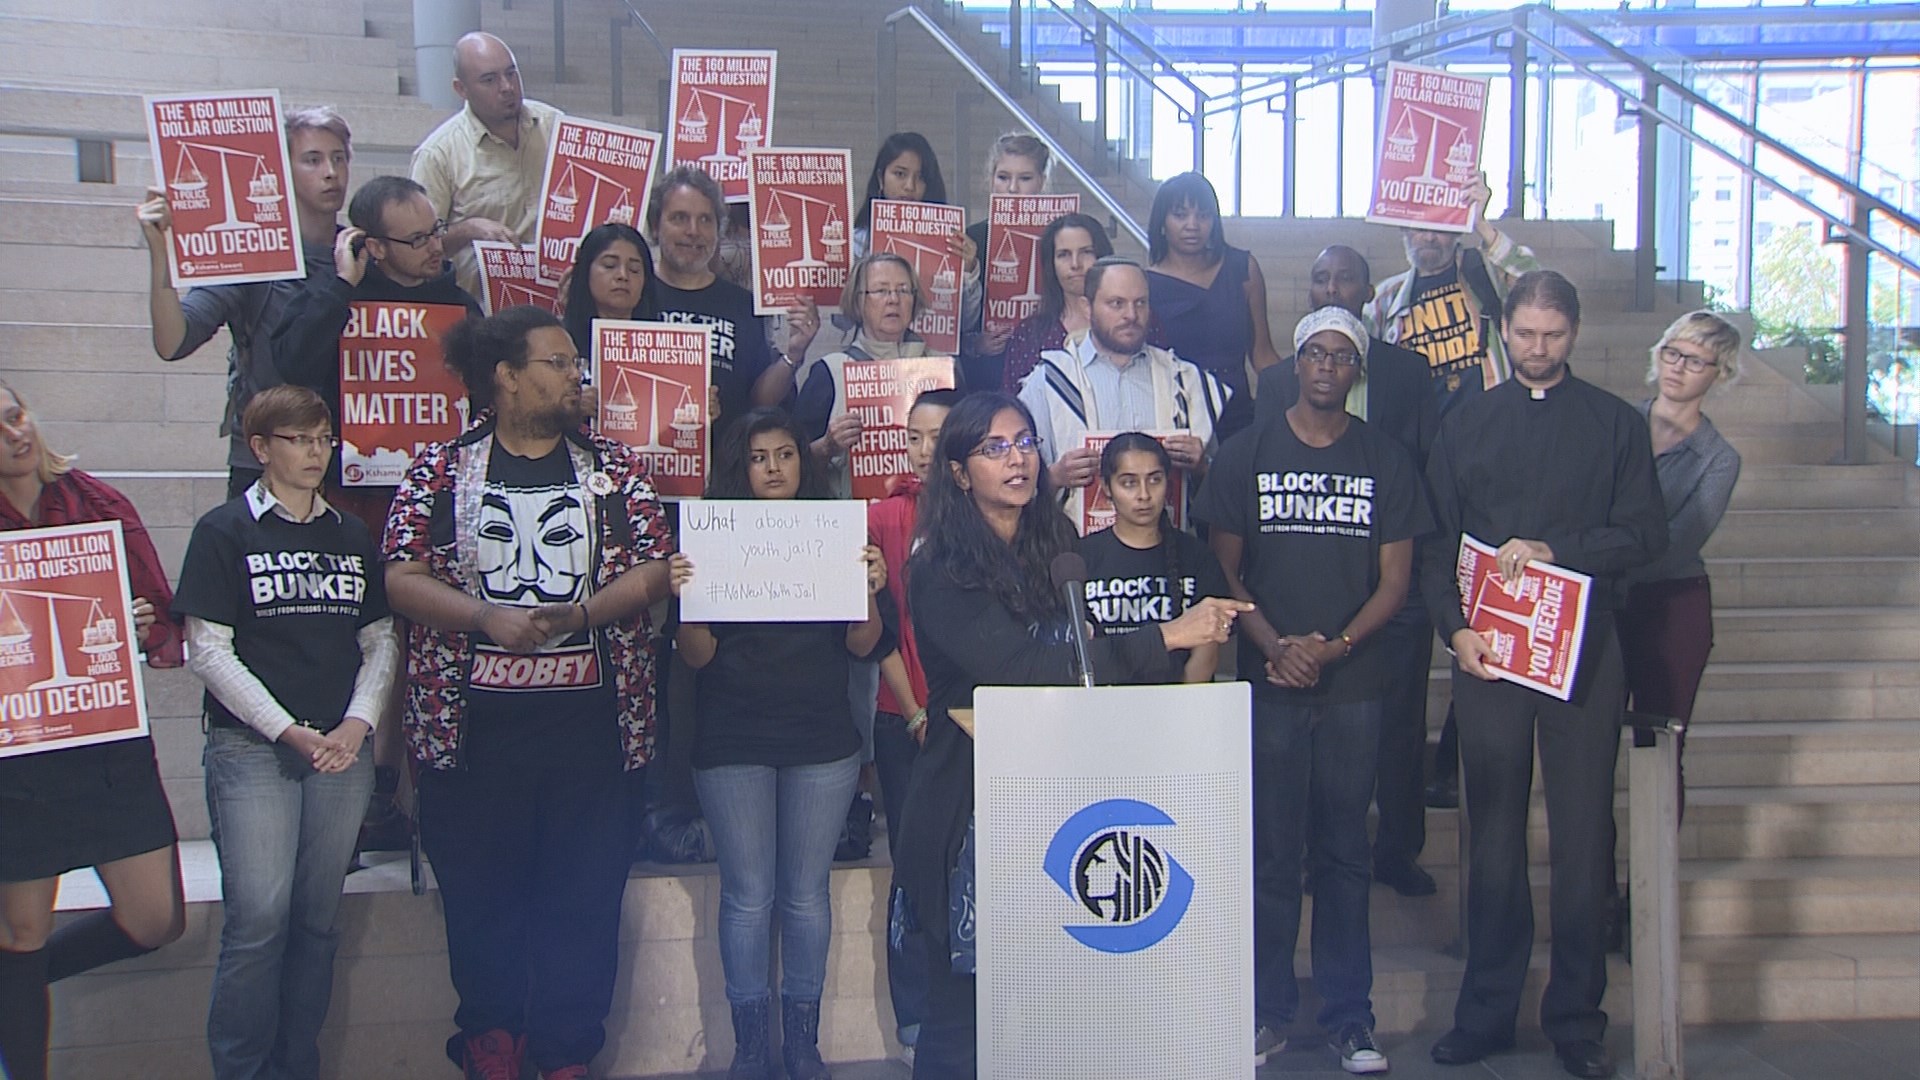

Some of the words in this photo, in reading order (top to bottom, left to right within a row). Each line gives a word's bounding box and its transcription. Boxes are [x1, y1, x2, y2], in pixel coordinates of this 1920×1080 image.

[682, 58, 700, 72] THE
[706, 58, 724, 72] 160
[726, 58, 768, 72] MILLION
[682, 72, 718, 85] DOLLAR
[720, 72, 766, 86] QUESTION
[1396, 72, 1416, 87] THE
[1420, 74, 1440, 90] 160
[1441, 78, 1482, 97] MILLION
[1394, 86, 1432, 103] DOLLAR
[1434, 92, 1481, 111] QUESTION
[157, 104, 185, 121] THE
[190, 103, 214, 119] 160
[218, 100, 270, 117] MILLION
[161, 120, 210, 137] DOLLAR
[214, 118, 274, 135] QUESTION
[562, 126, 581, 142] THE
[585, 130, 604, 146] 160
[606, 134, 650, 156] MILLION
[558, 141, 596, 162] DOLLAR
[597, 148, 648, 170] QUESTION
[756, 156, 777, 170] THE
[780, 156, 800, 170] 160
[802, 156, 842, 170] MILLION
[710, 161, 748, 180] DECID
[758, 171, 796, 184] DOLLAR
[798, 171, 844, 185] QUESTION
[1380, 180, 1410, 202] YOU
[172, 200, 210, 210] PRECINCT
[876, 204, 896, 218] THE
[900, 206, 919, 220] 160
[921, 208, 960, 223] MILLION
[994, 199, 1014, 212] THE
[1018, 199, 1036, 212] 160
[1038, 199, 1075, 212] MILLION
[876, 218, 913, 234] DOLLAR
[994, 213, 1030, 226] DOLLAR
[178, 231, 218, 256] YOU
[223, 228, 290, 254] DECIDE
[543, 237, 569, 262] YOU
[764, 268, 794, 288] YOU
[798, 268, 846, 288] DECIDE
[989, 300, 1016, 318] YOU
[344, 307, 428, 338] BLACK
[699, 315, 734, 338] THE
[910, 315, 954, 335] ECIDE
[604, 331, 626, 347] THE
[631, 332, 652, 348] 160
[656, 334, 702, 350] MILLION
[344, 350, 416, 382] LIVES
[604, 349, 646, 362] DOLLAR
[650, 350, 702, 365] QUESTION
[846, 366, 877, 382] MAKE
[344, 393, 448, 424] MATTER
[853, 453, 912, 477] HOUSIN
[1257, 472, 1328, 493] BLOCK
[1332, 474, 1374, 497] THE
[687, 504, 736, 532] What
[756, 508, 802, 530] about
[816, 514, 840, 530] the
[1259, 494, 1371, 524] BUNKER
[11, 542, 41, 562] 160
[44, 534, 110, 558] MILLION
[740, 541, 780, 567] youth
[784, 539, 824, 562] jail?
[0, 561, 36, 583] LLAR
[38, 554, 113, 578] QUESTION
[246, 551, 324, 574] BLOCK
[324, 552, 364, 574] THE
[250, 573, 366, 604] BUNKER
[1086, 576, 1151, 600] BLOCK
[1156, 577, 1194, 596] TE
[1538, 576, 1565, 642] DECIDE
[0, 653, 34, 666] ECINCT
[87, 662, 121, 675] HOMES
[90, 651, 118, 663] 1,000
[1528, 640, 1552, 678] YOU
[471, 654, 593, 686] DISOBEY
[48, 680, 130, 716] DECIDE
